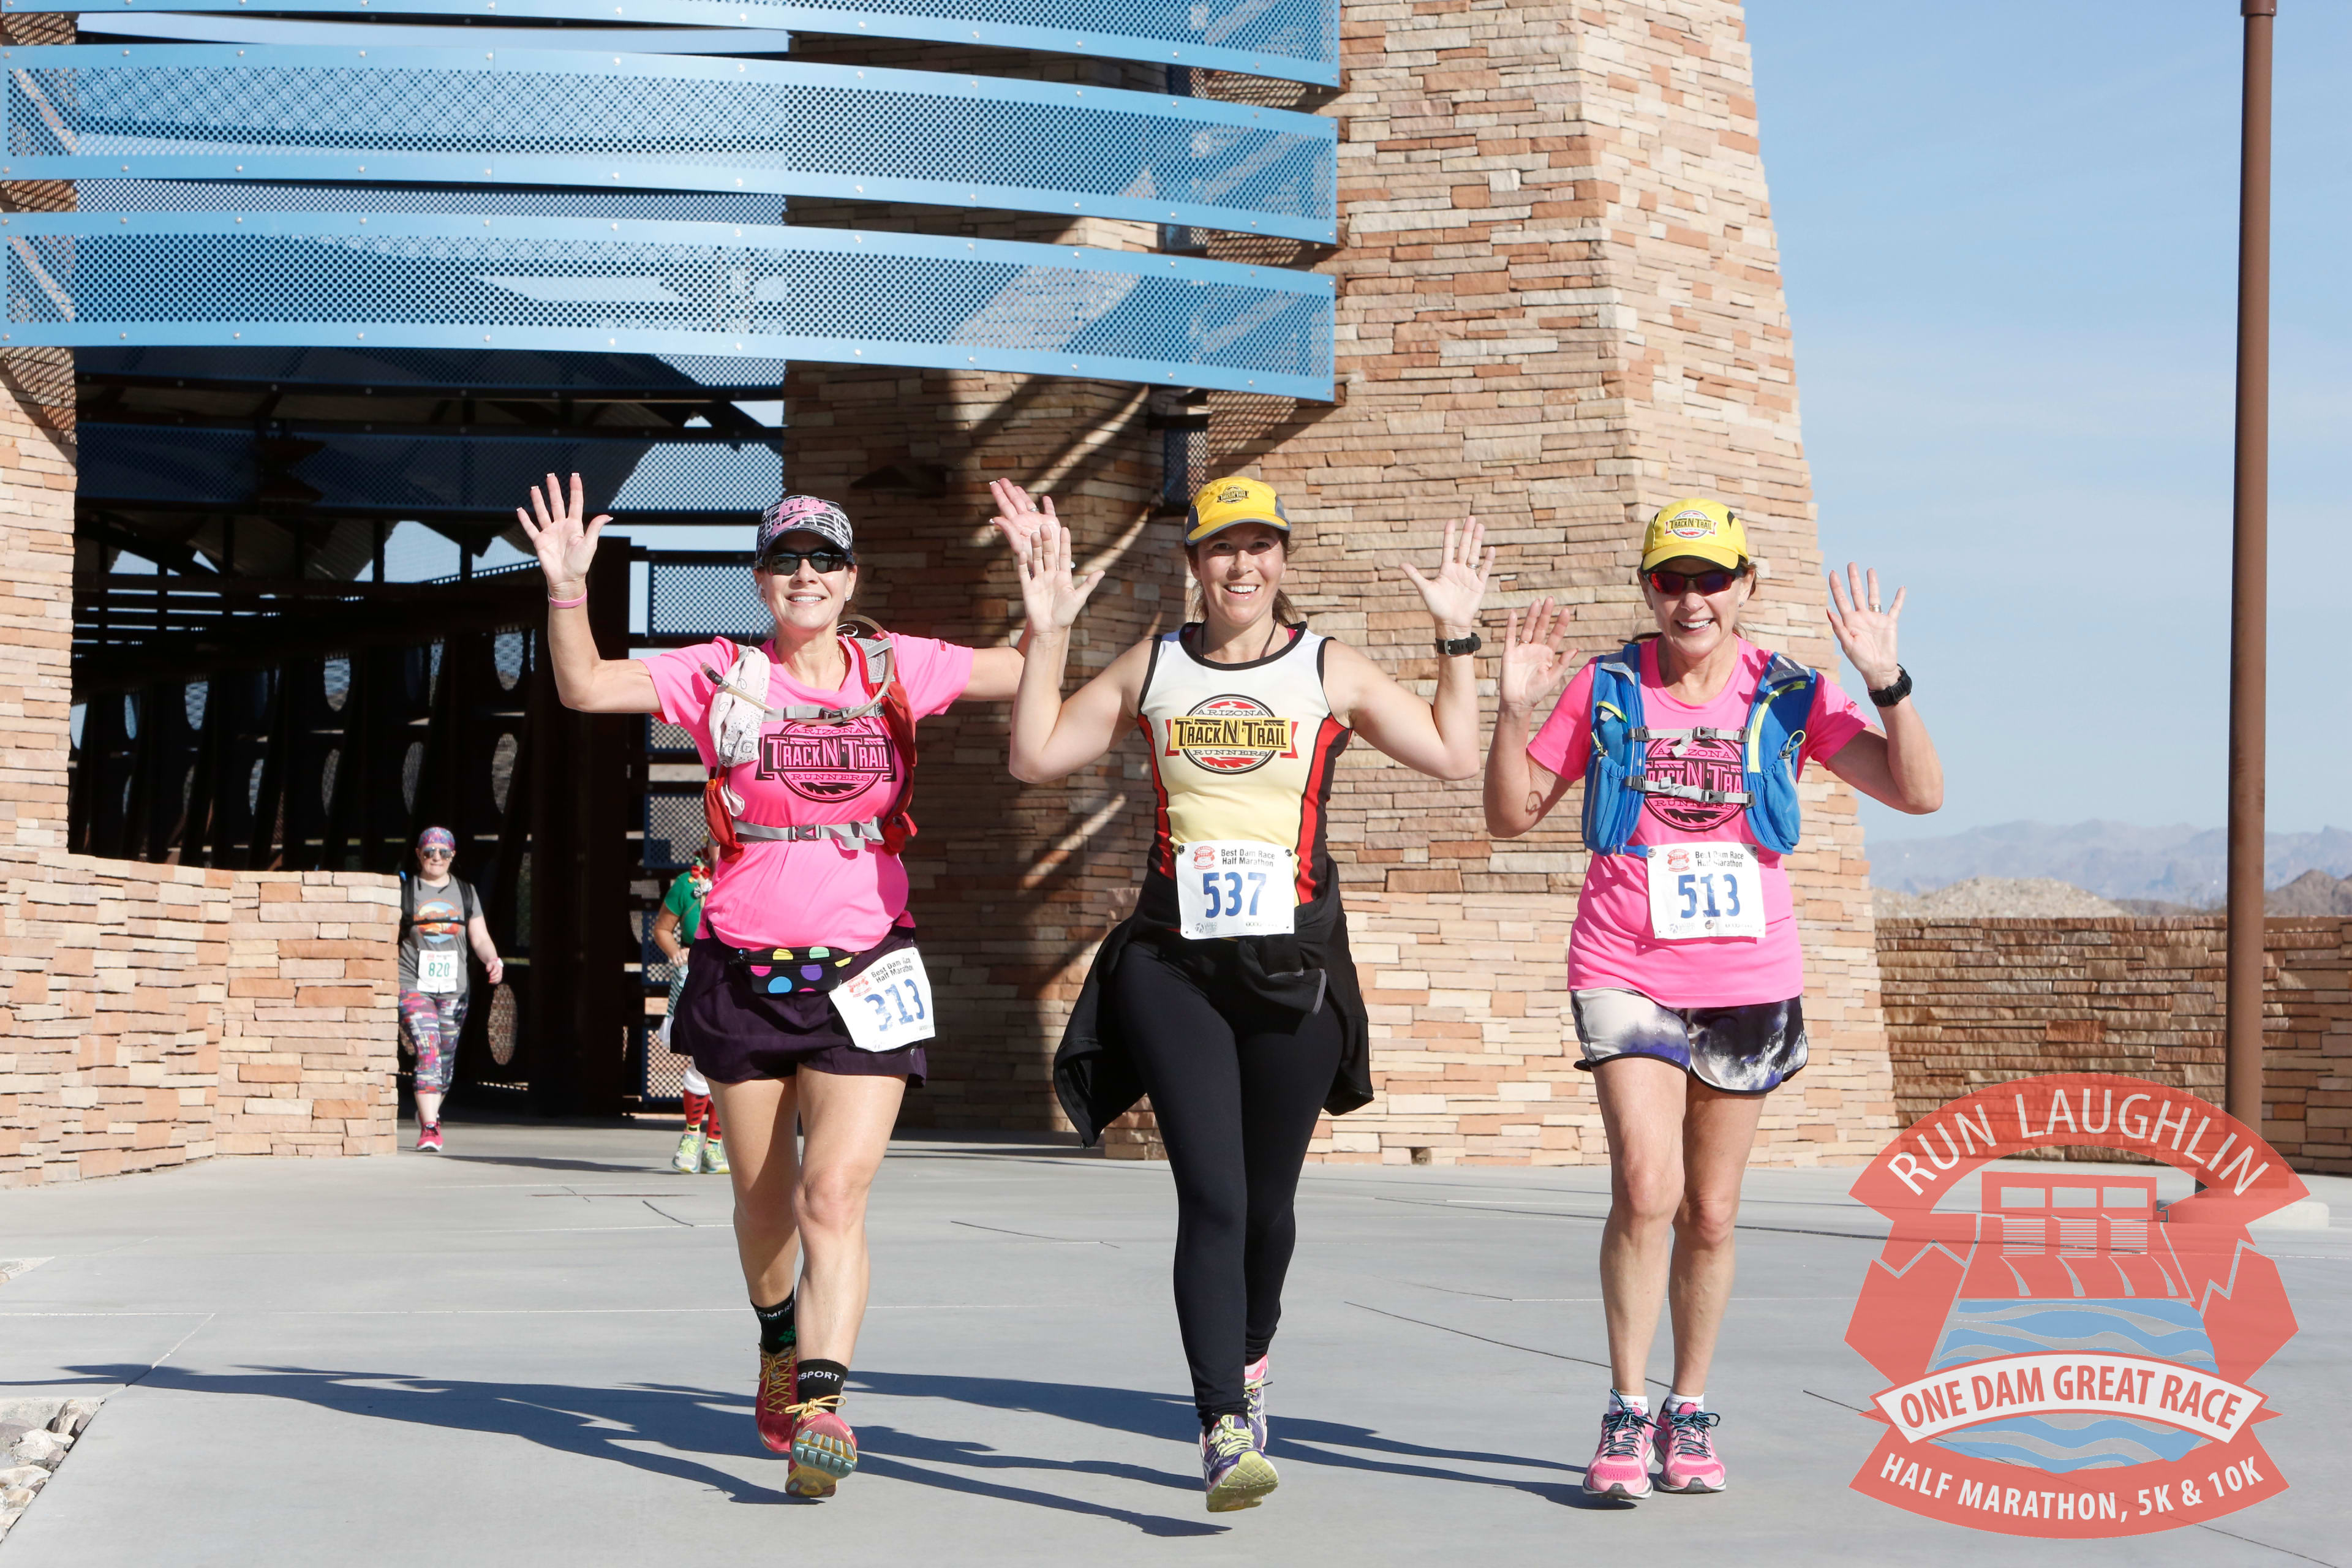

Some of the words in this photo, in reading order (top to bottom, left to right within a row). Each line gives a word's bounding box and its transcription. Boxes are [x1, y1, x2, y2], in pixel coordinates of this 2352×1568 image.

[791, 726, 864, 735] ARIZONA
[1655, 748, 1733, 759] AZONA
[791, 774, 870, 782] RUNNERS
[1258, 850, 1275, 859] Race
[1239, 857, 1273, 867] Marathon
[1203, 872, 1267, 919] 537
[1678, 873, 1741, 919] 513
[429, 962, 450, 977] 820
[871, 967, 887, 978] Best
[887, 960, 901, 970] Dam
[875, 972, 889, 983] Half
[864, 979, 925, 1031] 313
